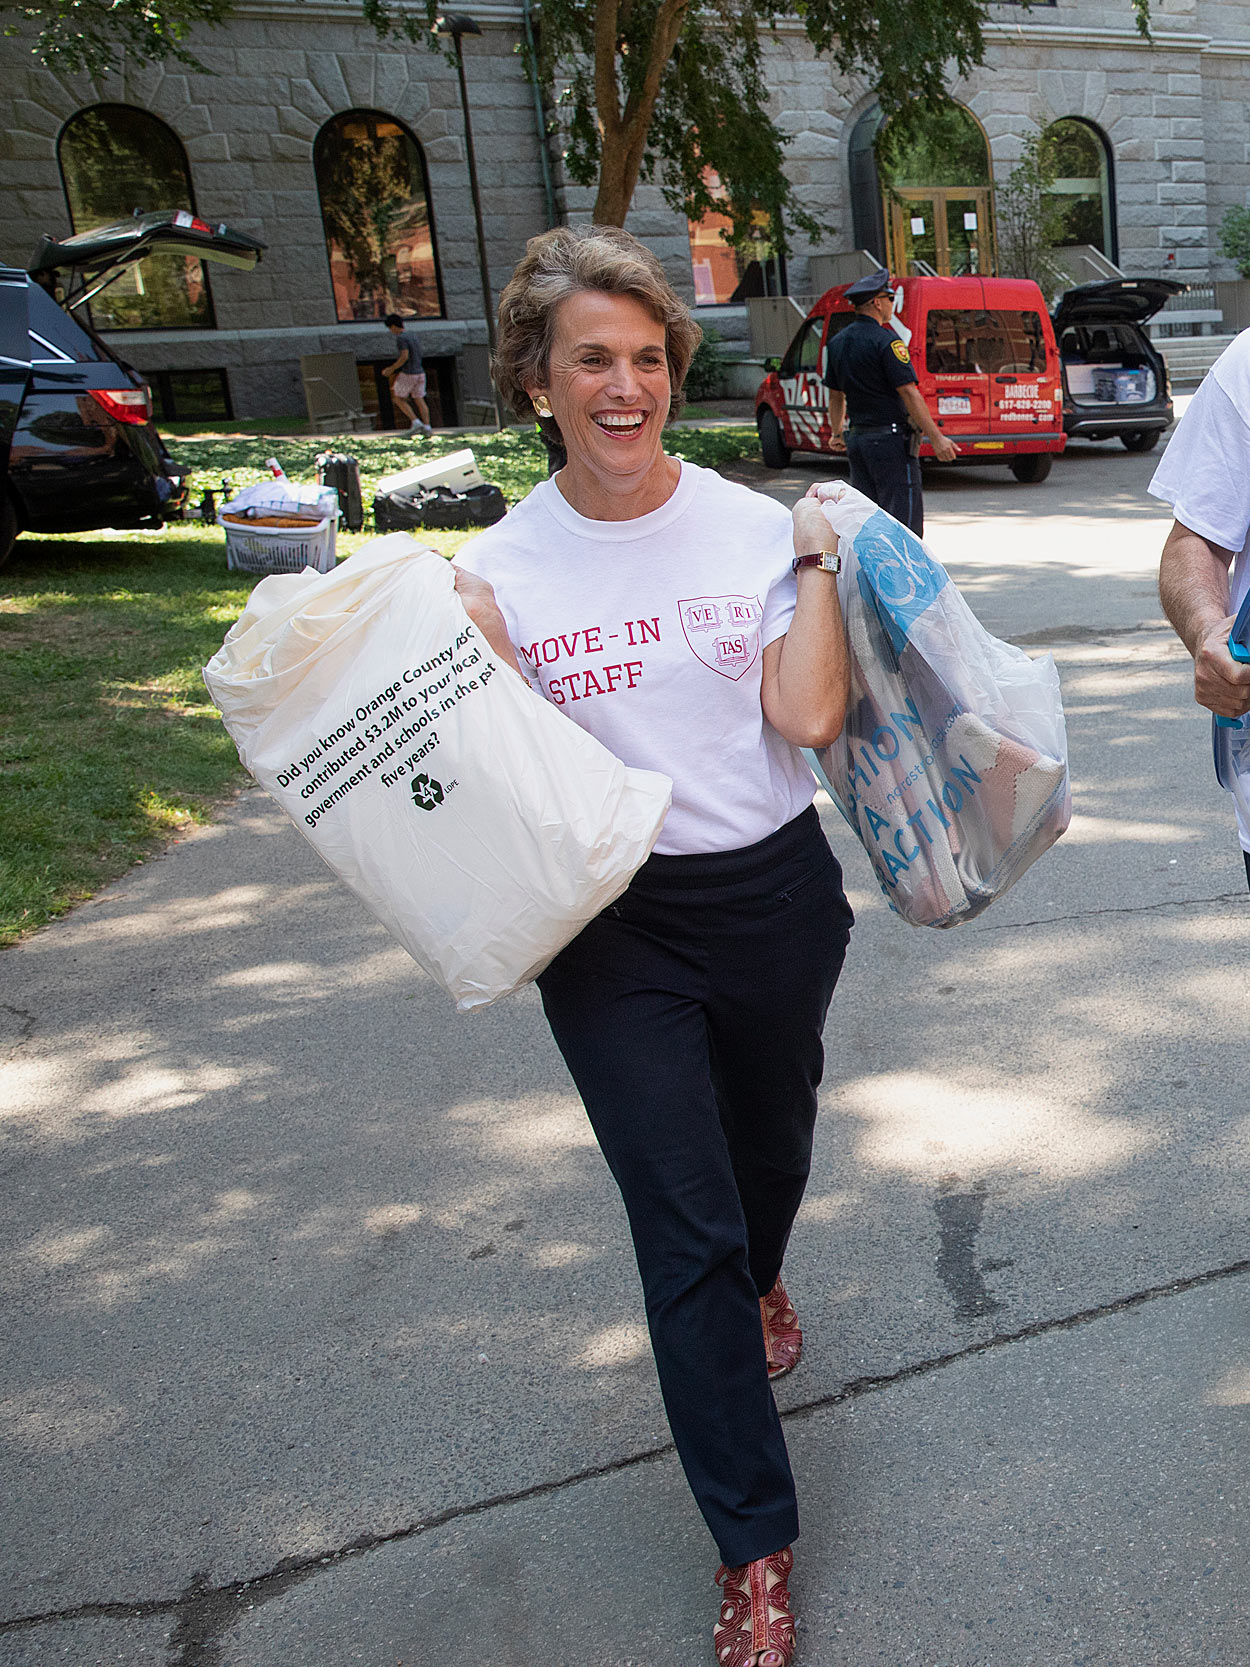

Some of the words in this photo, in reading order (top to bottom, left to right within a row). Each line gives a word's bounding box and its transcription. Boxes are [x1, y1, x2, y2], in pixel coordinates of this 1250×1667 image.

[1005, 384, 1039, 399] BARBECUE
[692, 608, 713, 622] VE
[734, 605, 751, 619] RI
[520, 617, 662, 668] MOVE-IN
[719, 639, 743, 656] TAS
[549, 661, 644, 705] STAFF
[276, 763, 302, 788] Did
[299, 747, 323, 773] you
[318, 717, 356, 751] know
[355, 681, 402, 722] Orange
[402, 647, 454, 684] County
[300, 736, 367, 799] contributed
[364, 705, 405, 744] $3.2M
[402, 697, 418, 712] to
[418, 672, 451, 703] your
[451, 648, 482, 676] local
[304, 763, 372, 828] government
[370, 741, 396, 770] and
[394, 709, 440, 749] schools
[439, 697, 456, 712] in
[455, 678, 479, 700] the
[380, 765, 406, 788] five
[404, 731, 441, 772] years?
[444, 779, 460, 795] LDPE
